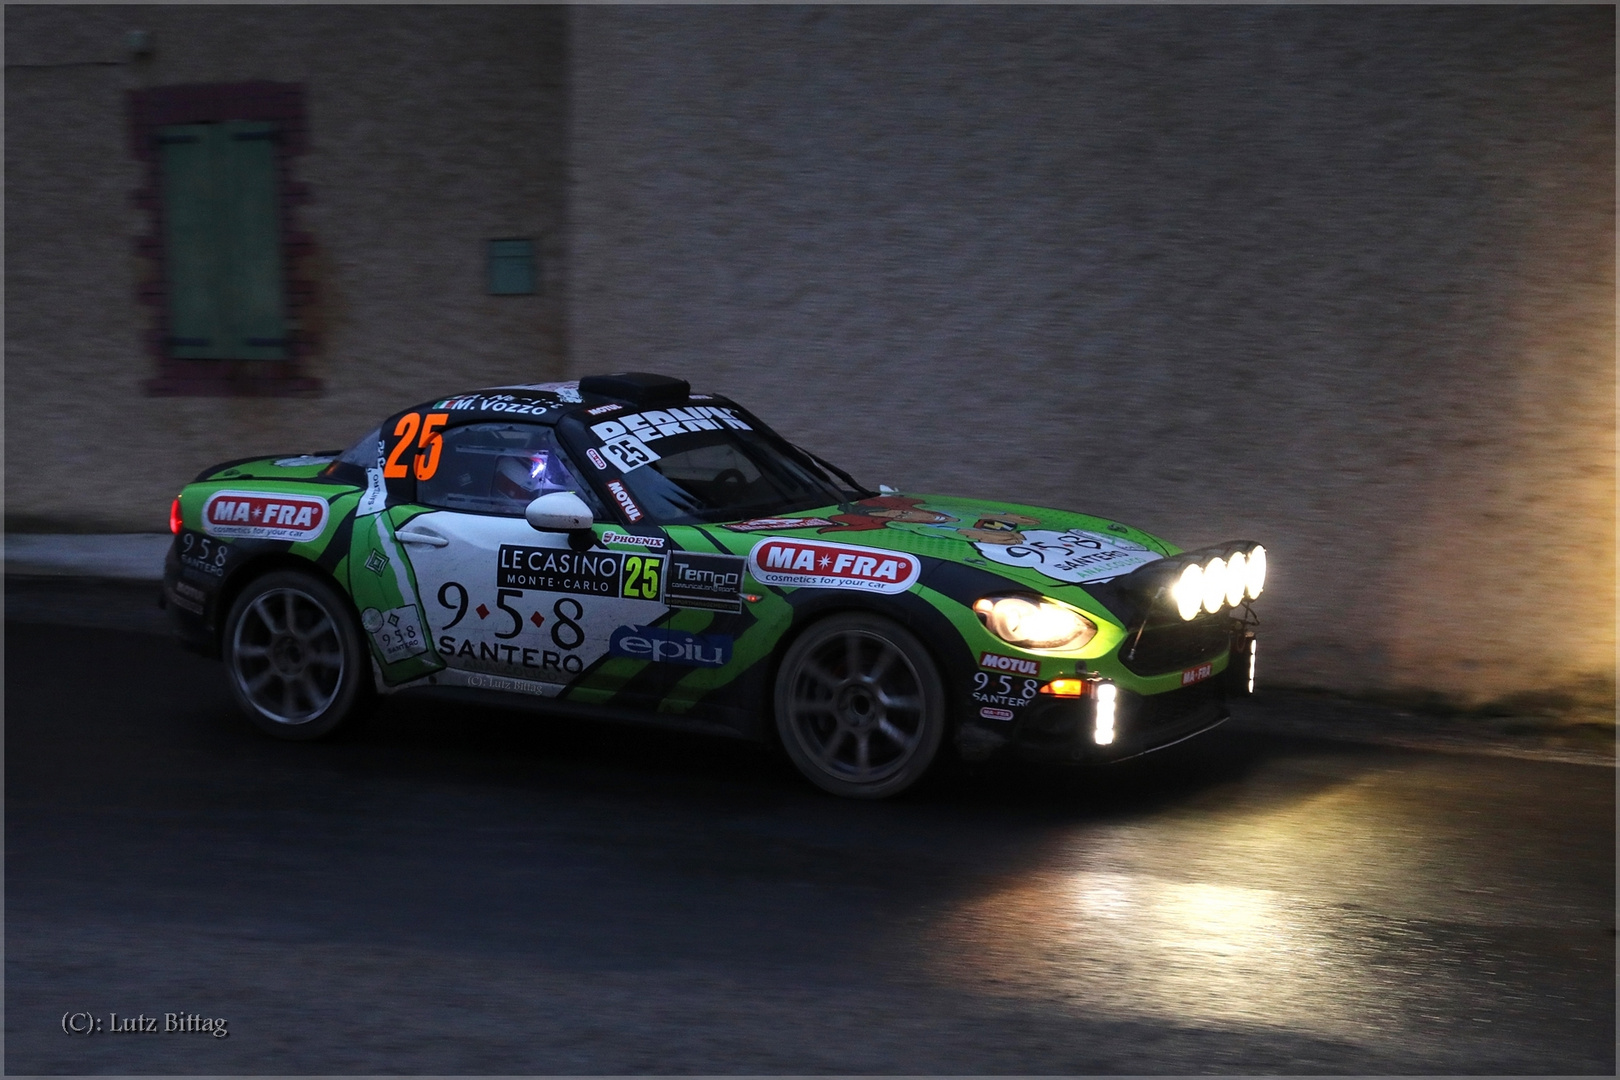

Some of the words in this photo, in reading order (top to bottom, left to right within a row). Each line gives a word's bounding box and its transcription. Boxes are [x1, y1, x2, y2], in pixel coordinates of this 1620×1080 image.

[383, 412, 449, 481] 25
[608, 440, 650, 468] 25
[607, 481, 642, 521] MOTUL
[213, 526, 251, 535] cosmetics
[253, 527, 265, 535] for
[266, 529, 287, 537] your
[613, 535, 664, 547] PHOENIX
[501, 549, 523, 569] LE
[527, 551, 617, 577] CASINO
[623, 556, 660, 599] 25
[765, 573, 816, 583] cosmetics
[836, 578, 865, 588] your
[438, 635, 584, 674] SANTERO
[619, 636, 724, 665] epiu
[981, 653, 1038, 675] MOTUL
